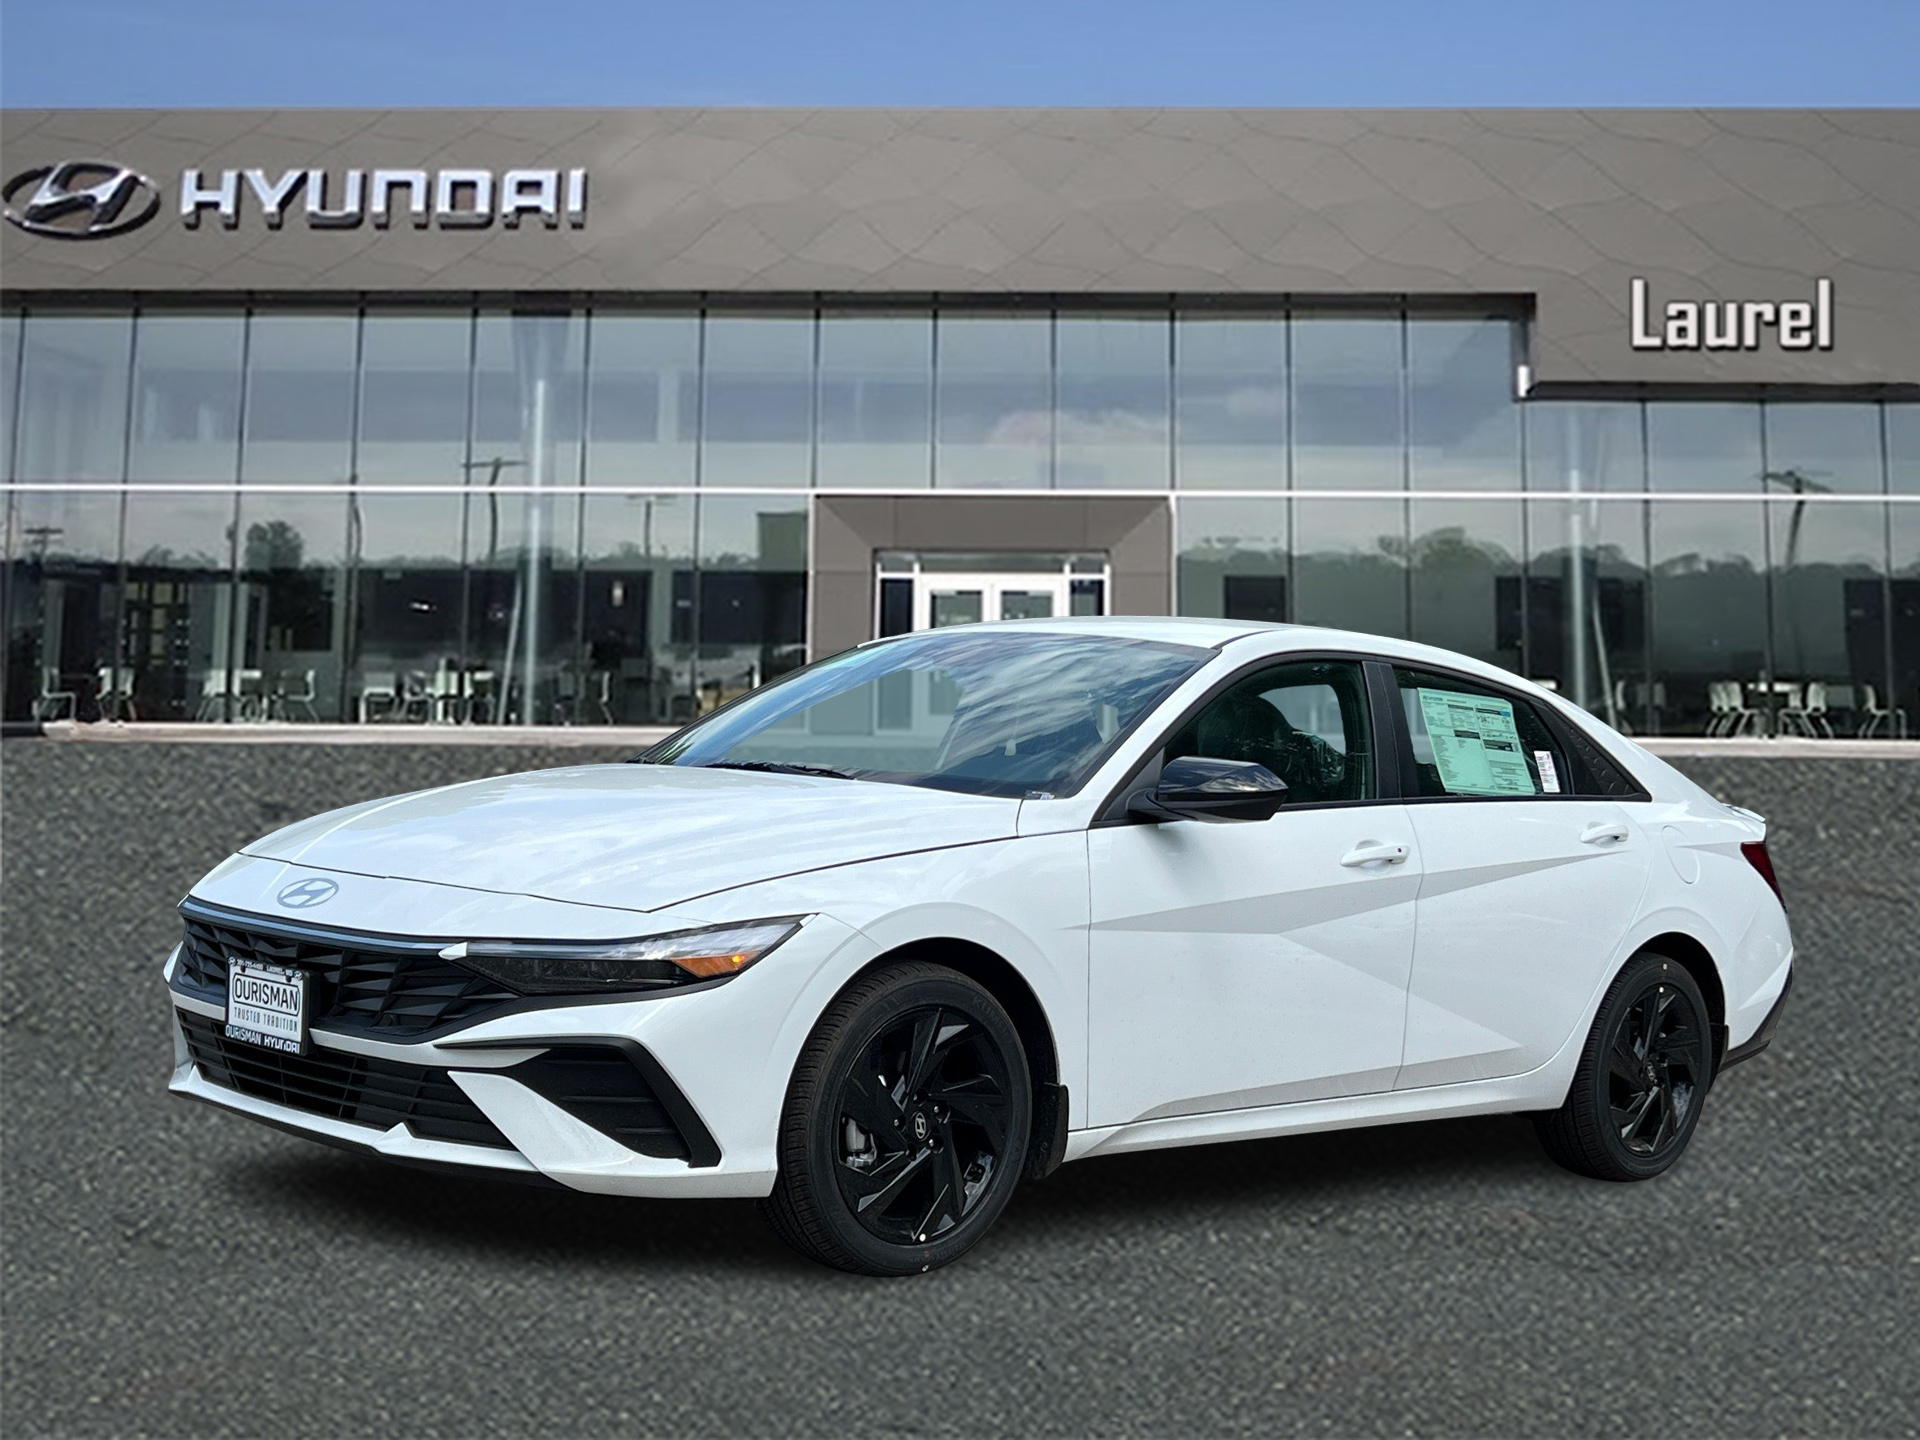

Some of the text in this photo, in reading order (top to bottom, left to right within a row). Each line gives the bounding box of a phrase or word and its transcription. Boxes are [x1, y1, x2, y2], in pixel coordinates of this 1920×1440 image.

[180, 168, 587, 230] HYUNDAI
[1631, 278, 1832, 349] Laurel
[234, 978, 298, 1011] OURISMAN
[234, 1007, 298, 1032] TRUSTED TRADITION
[225, 1024, 300, 1054] OURISMAN HYUNDAI
